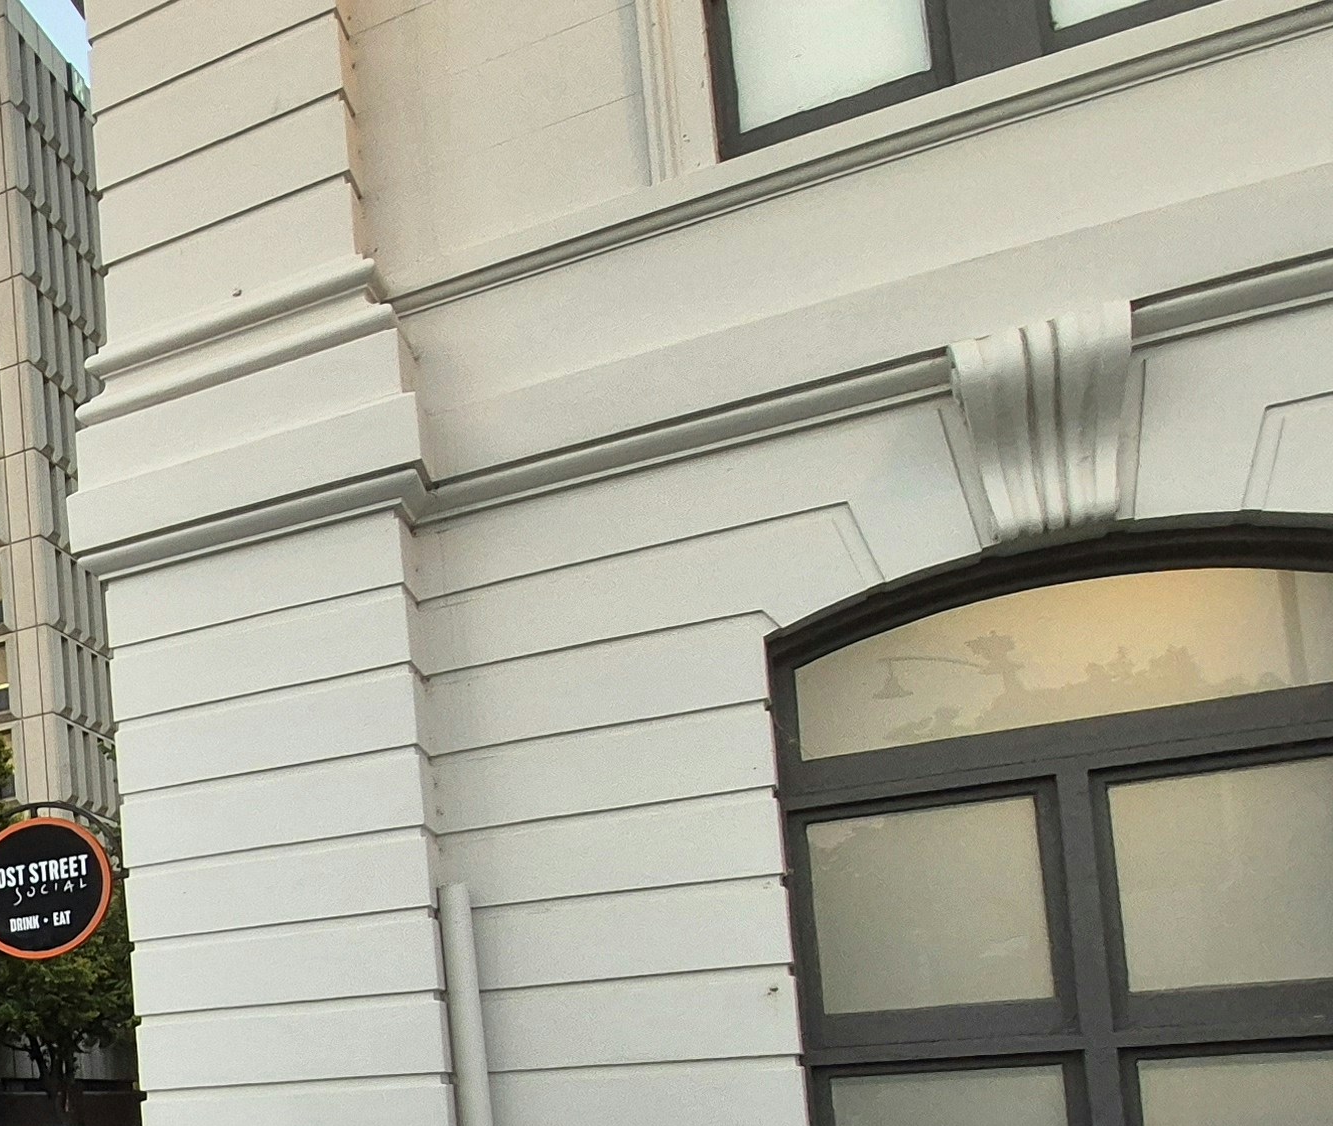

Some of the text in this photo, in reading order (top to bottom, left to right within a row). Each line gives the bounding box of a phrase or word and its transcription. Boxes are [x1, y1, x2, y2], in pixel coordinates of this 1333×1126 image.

[29, 854, 88, 884] STREET
[13, 878, 87, 906] SOCIAL
[9, 910, 71, 932] DRINK EAT
